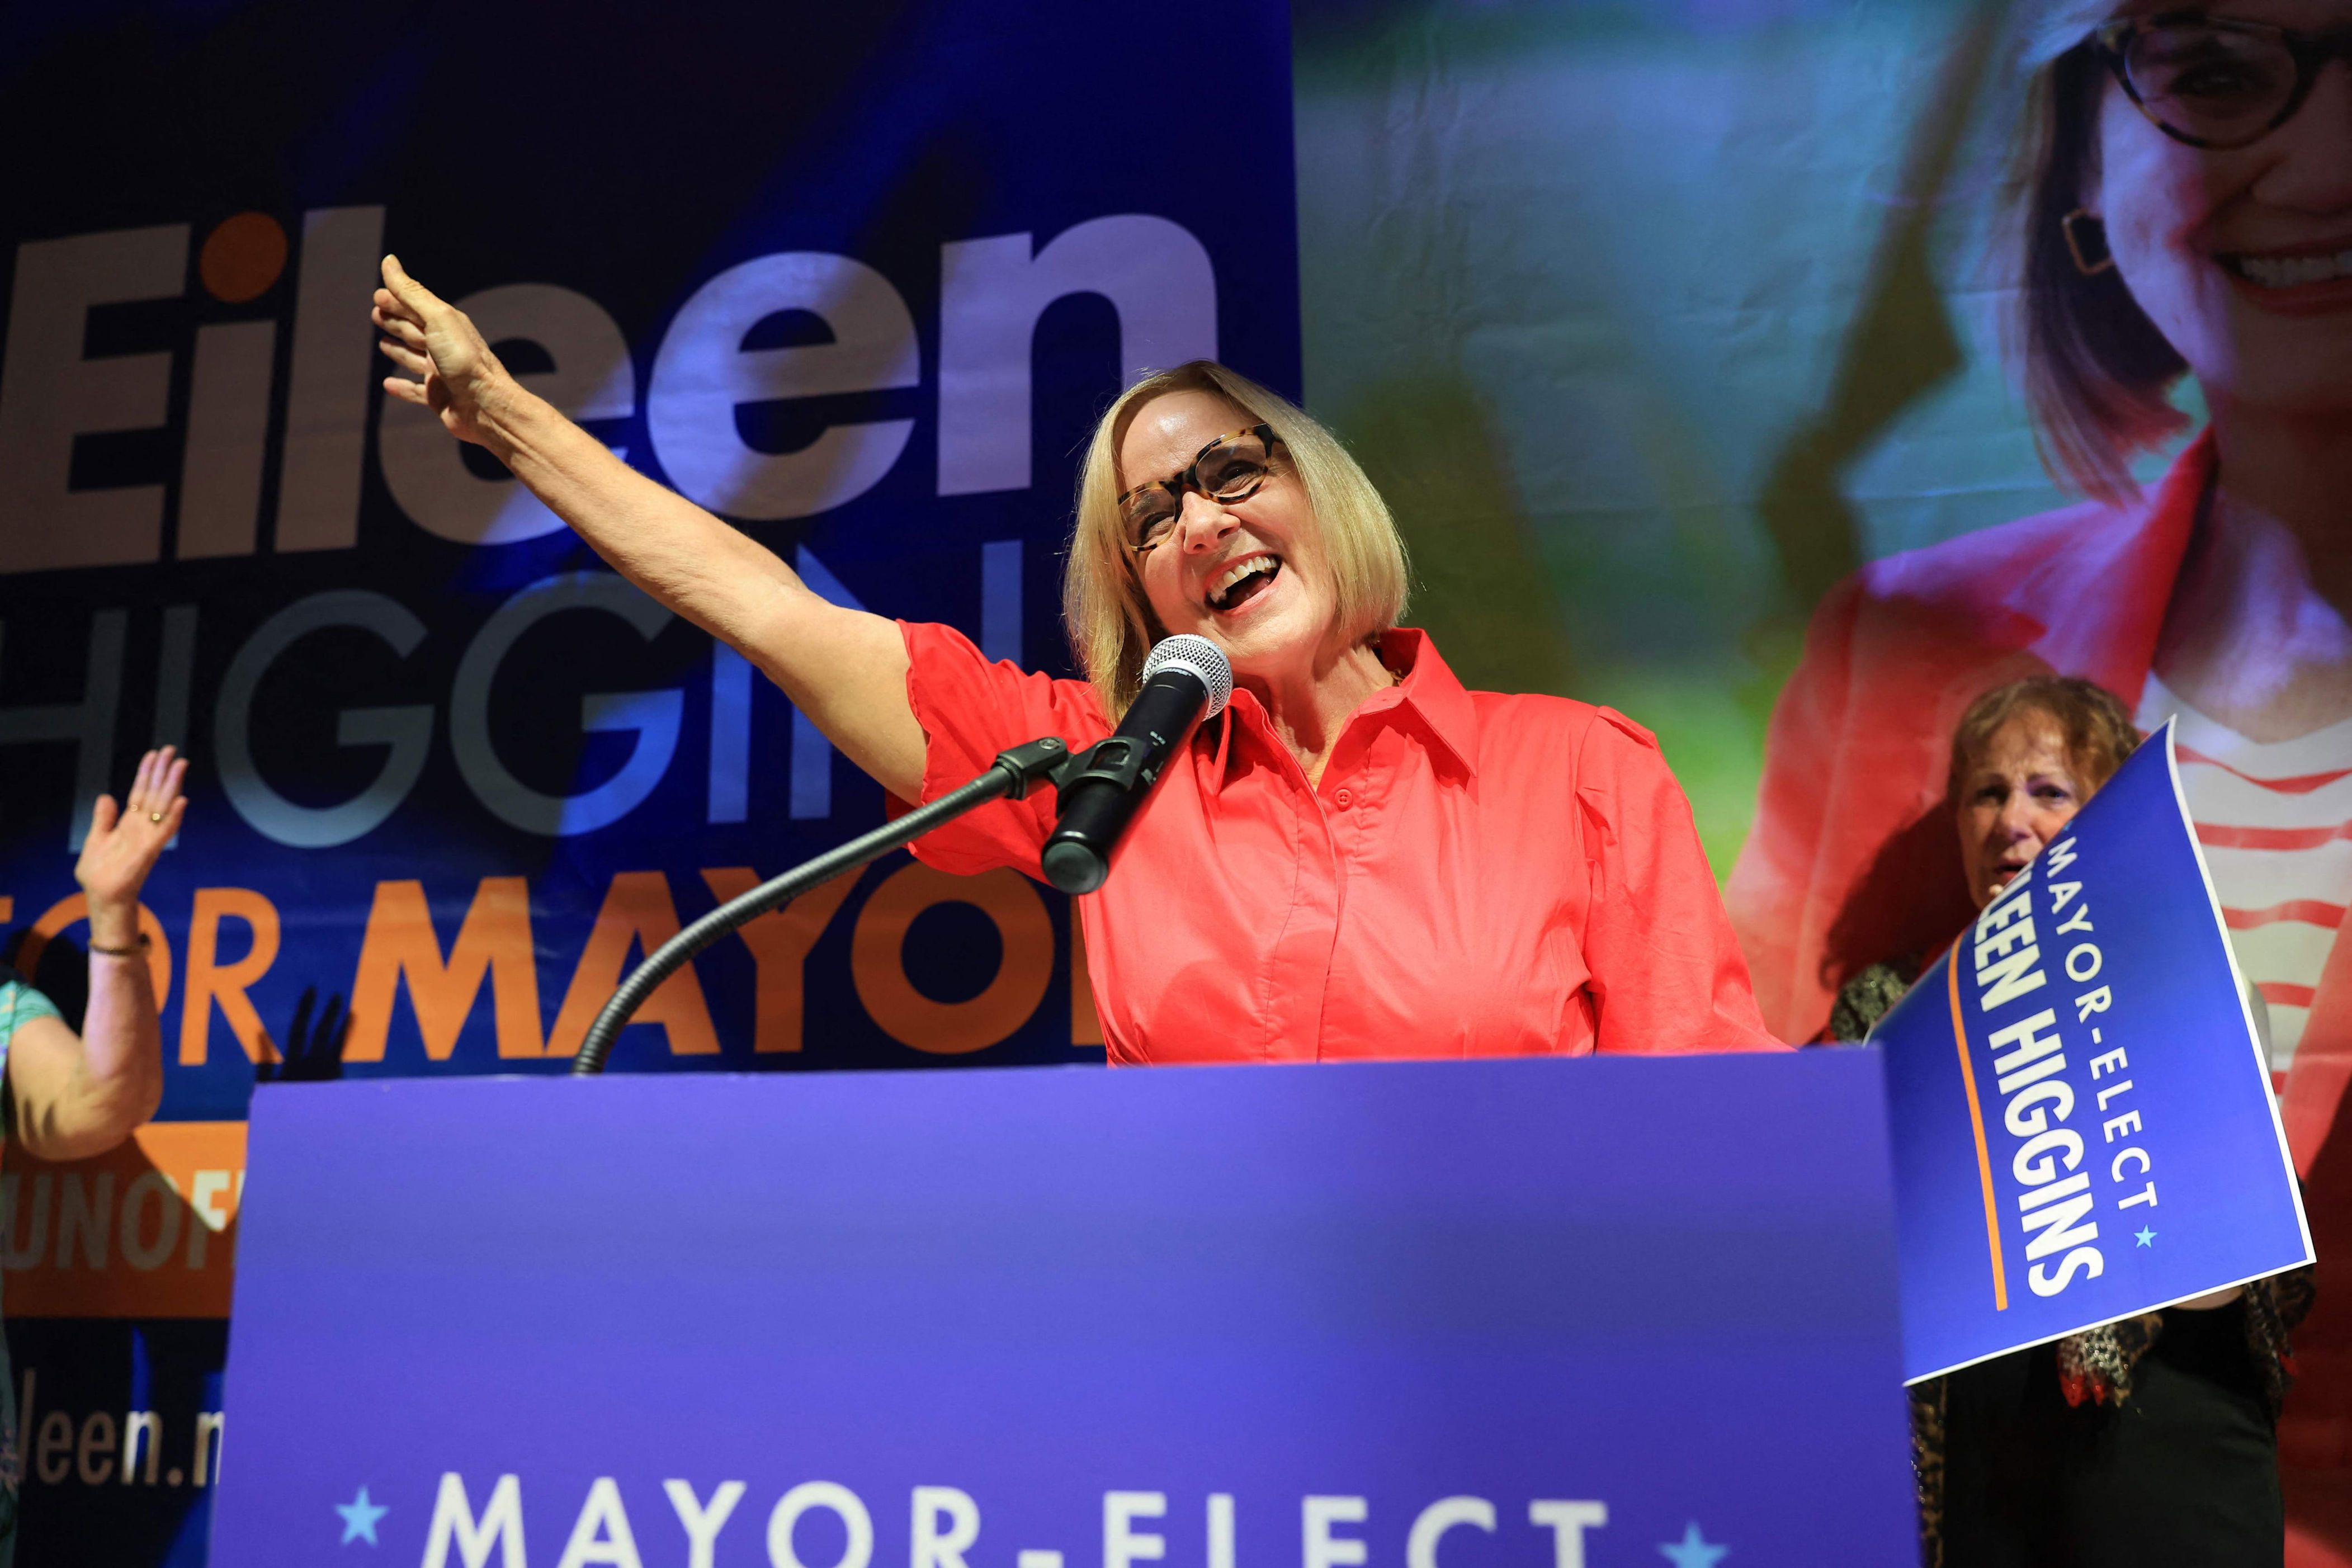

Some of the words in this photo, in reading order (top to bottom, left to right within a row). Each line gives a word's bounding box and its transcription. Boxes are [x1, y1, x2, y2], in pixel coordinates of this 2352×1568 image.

[0, 204, 1218, 574] Eileen
[342, 864, 1106, 1062] MAYO
[1974, 858, 2047, 1012] LEEN
[2047, 836, 2157, 1211] MAYOR-ELECT
[1, 1169, 245, 1271] UNOF
[1989, 1008, 2104, 1297] HIGGINS
